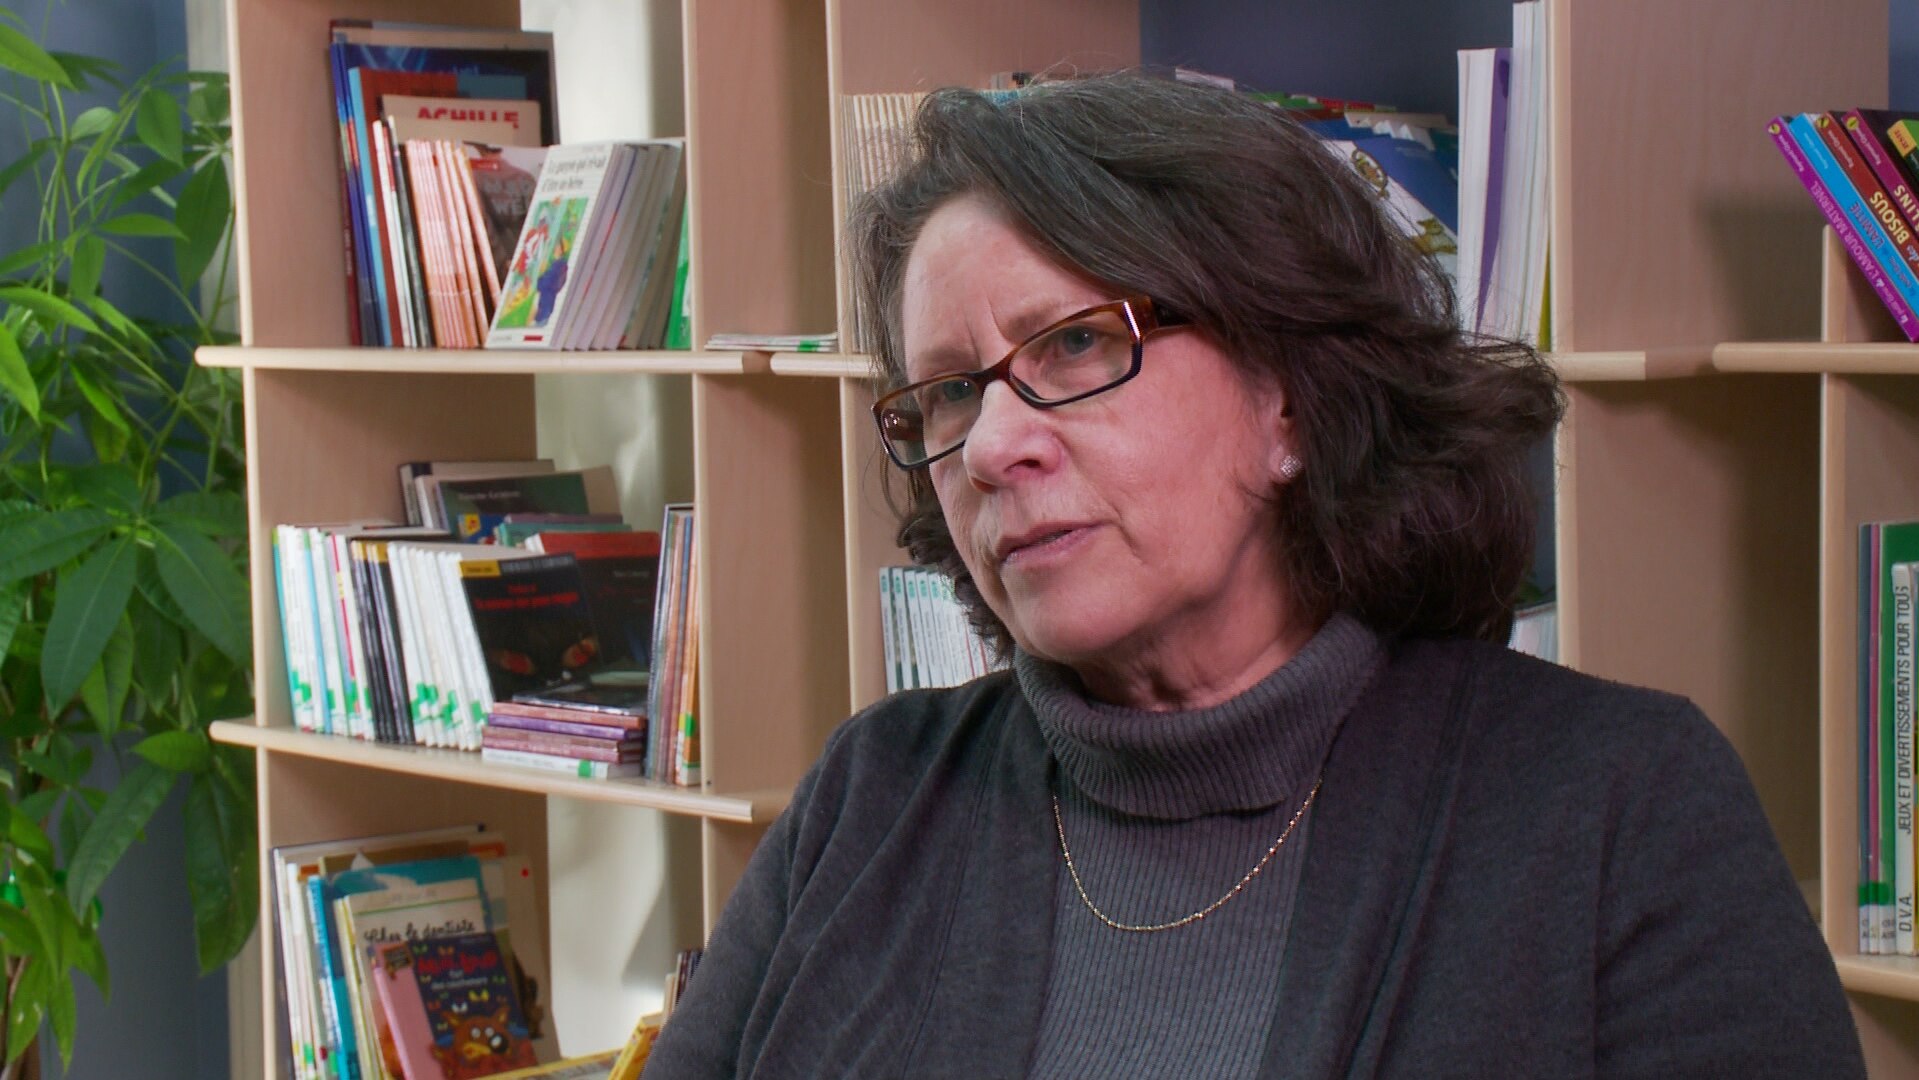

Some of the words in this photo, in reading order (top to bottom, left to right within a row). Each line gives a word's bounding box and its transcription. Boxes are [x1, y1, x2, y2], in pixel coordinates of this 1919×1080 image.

[1810, 181, 1848, 234] MATERNEL
[1870, 191, 1910, 245] BISOUS
[1844, 231, 1880, 280] L'AMOUR
[1896, 621, 1910, 656] POUR
[1896, 660, 1911, 779] DIVERTISSEMENTS
[1897, 782, 1911, 799] ET
[1897, 801, 1911, 835] JEUX
[1898, 893, 1912, 932] D.V.A.
